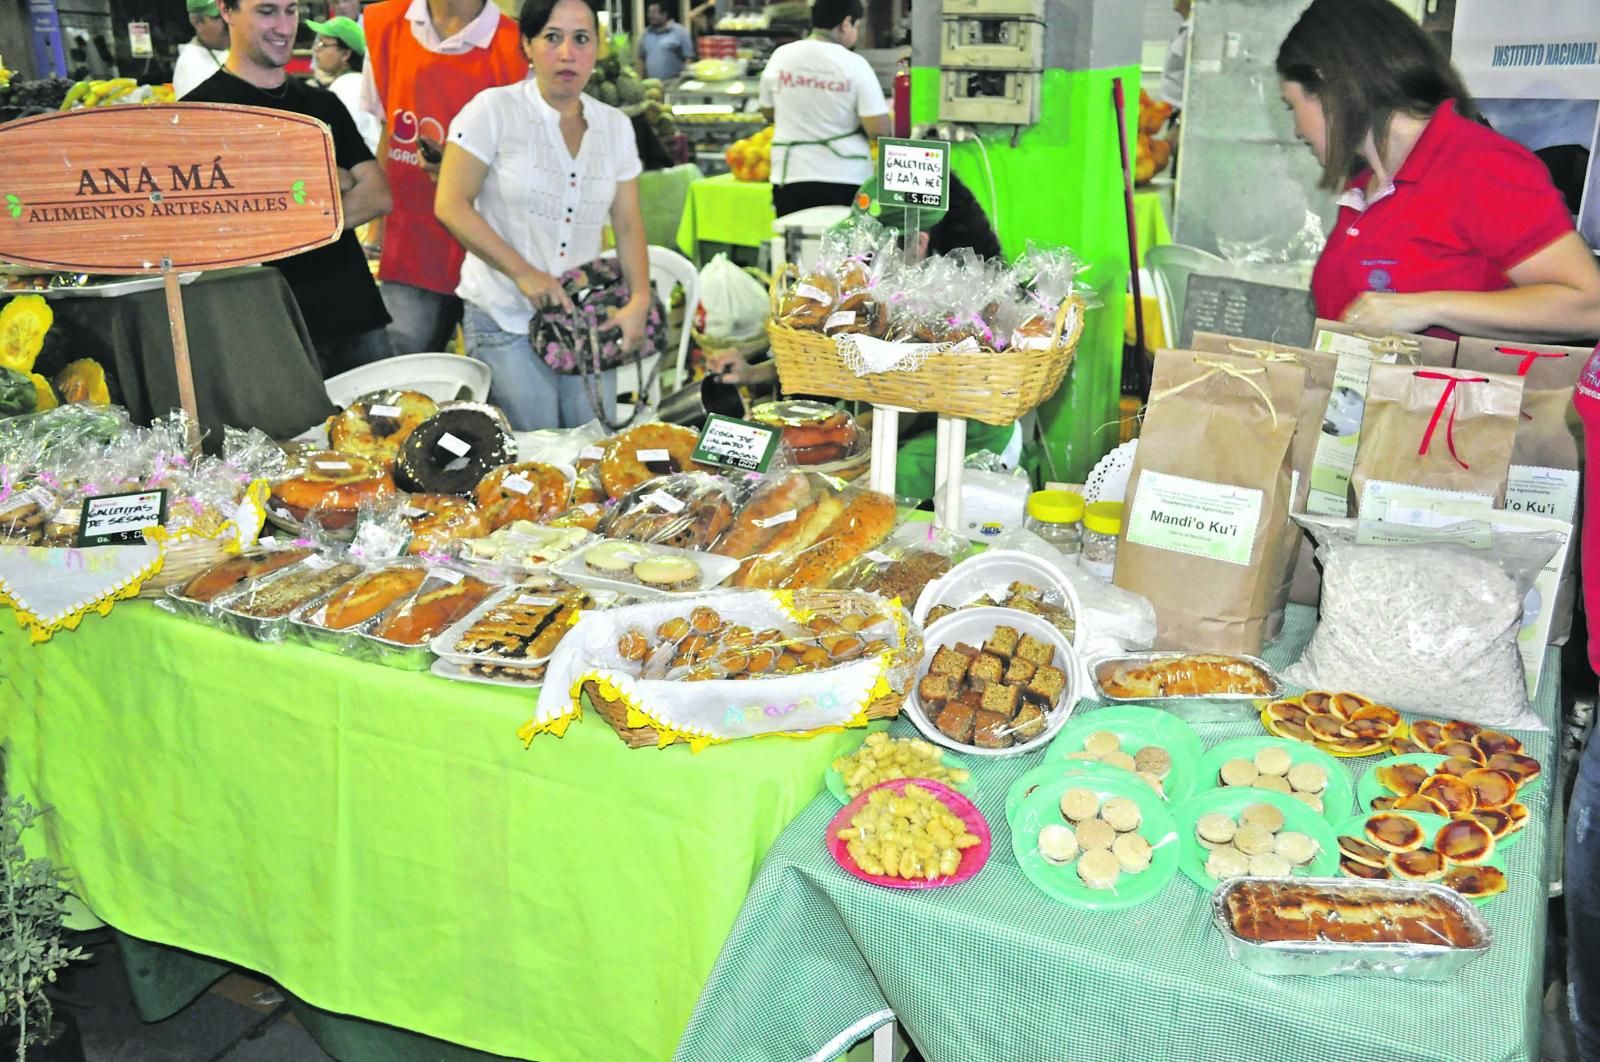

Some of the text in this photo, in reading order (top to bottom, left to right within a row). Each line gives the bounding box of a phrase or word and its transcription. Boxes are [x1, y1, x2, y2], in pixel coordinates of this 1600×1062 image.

[1492, 42, 1597, 66] INSTITUTO NACIONAL
[886, 157, 941, 172] GALLETITAS
[76, 156, 235, 196] ANA MÁ
[911, 193, 940, 205] 5.000
[29, 197, 289, 223] ALIMENTOS ARTESANALES
[88, 504, 153, 517] GALLETITAS
[1526, 501, 1555, 514] Ku'i
[87, 520, 104, 528] DE
[1150, 510, 1238, 536] Mandi'o Ku'i
